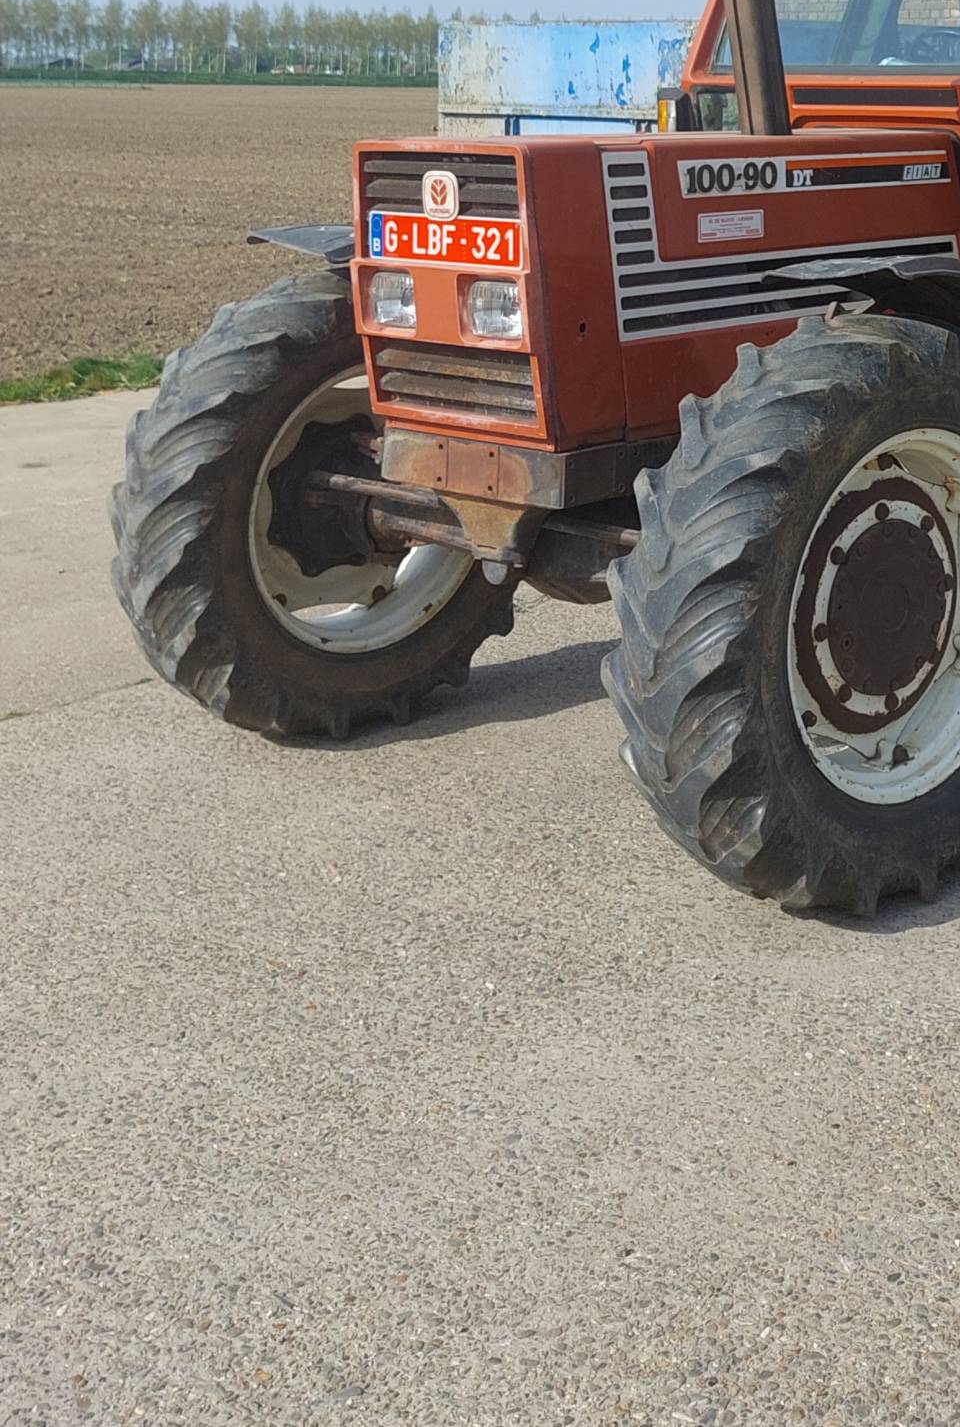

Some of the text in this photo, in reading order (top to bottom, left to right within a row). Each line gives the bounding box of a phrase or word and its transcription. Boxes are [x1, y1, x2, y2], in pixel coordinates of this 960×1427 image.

[686, 161, 814, 194] 100-90 DT
[903, 164, 941, 180] FIAT
[372, 237, 381, 252] B
